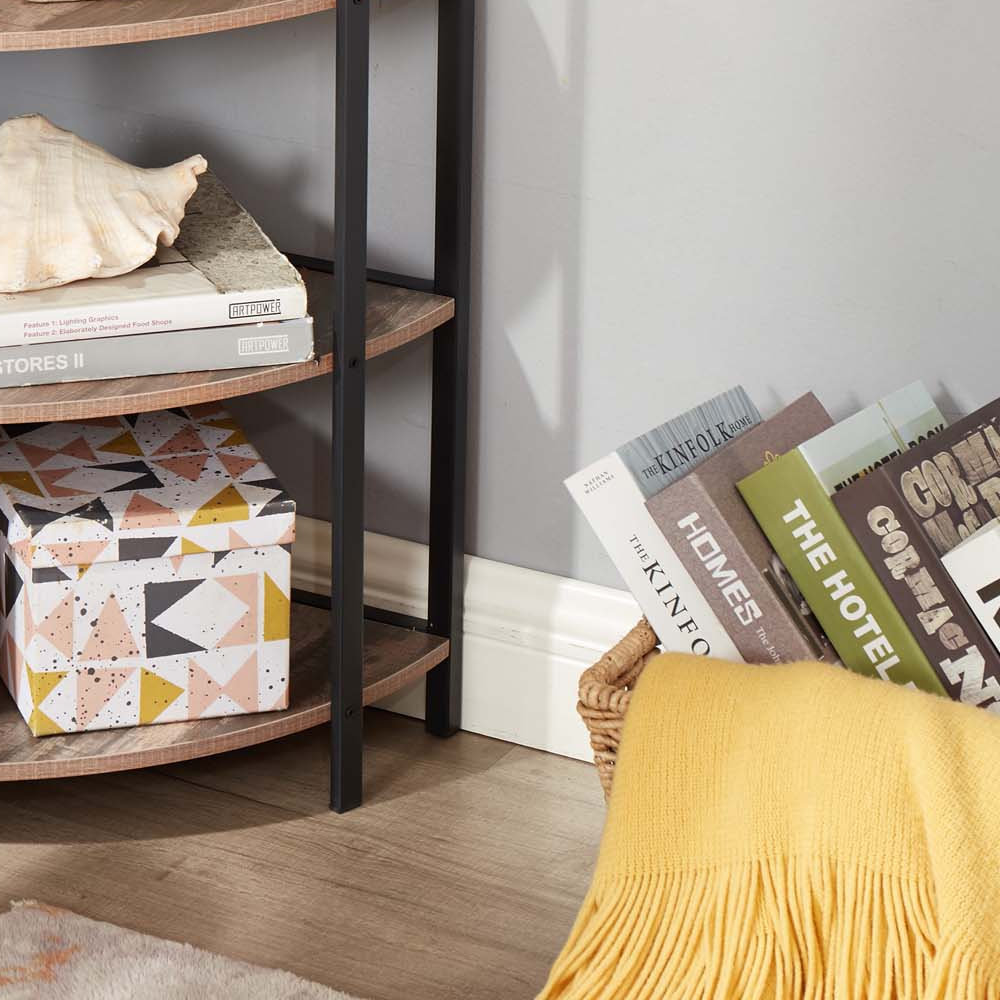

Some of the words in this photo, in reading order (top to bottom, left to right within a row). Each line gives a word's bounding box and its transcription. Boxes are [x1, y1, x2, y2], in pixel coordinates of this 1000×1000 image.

[232, 301, 281, 316] ARTPOWER
[23, 321, 50, 329] Feature
[59, 318, 87, 327] Lighting
[88, 315, 119, 324] Graphics
[23, 330, 50, 338] Feature
[59, 326, 97, 335] Elaborately
[99, 323, 131, 332] Designed
[132, 320, 150, 328] Food
[151, 318, 173, 327] Shops
[240, 337, 289, 353] ARTPOWER
[74, 353, 84, 368] II
[642, 464, 659, 479] THE
[654, 421, 734, 475] KINFOLK
[728, 415, 752, 433] HOME
[583, 471, 609, 487] NATHAN
[677, 511, 763, 626] HOMES
[756, 626, 769, 645] The
[867, 505, 969, 650] CORMAC
[629, 534, 650, 563] THE
[642, 560, 711, 656] KINFO
[782, 498, 838, 572] THE
[822, 569, 900, 681] HOTEL
